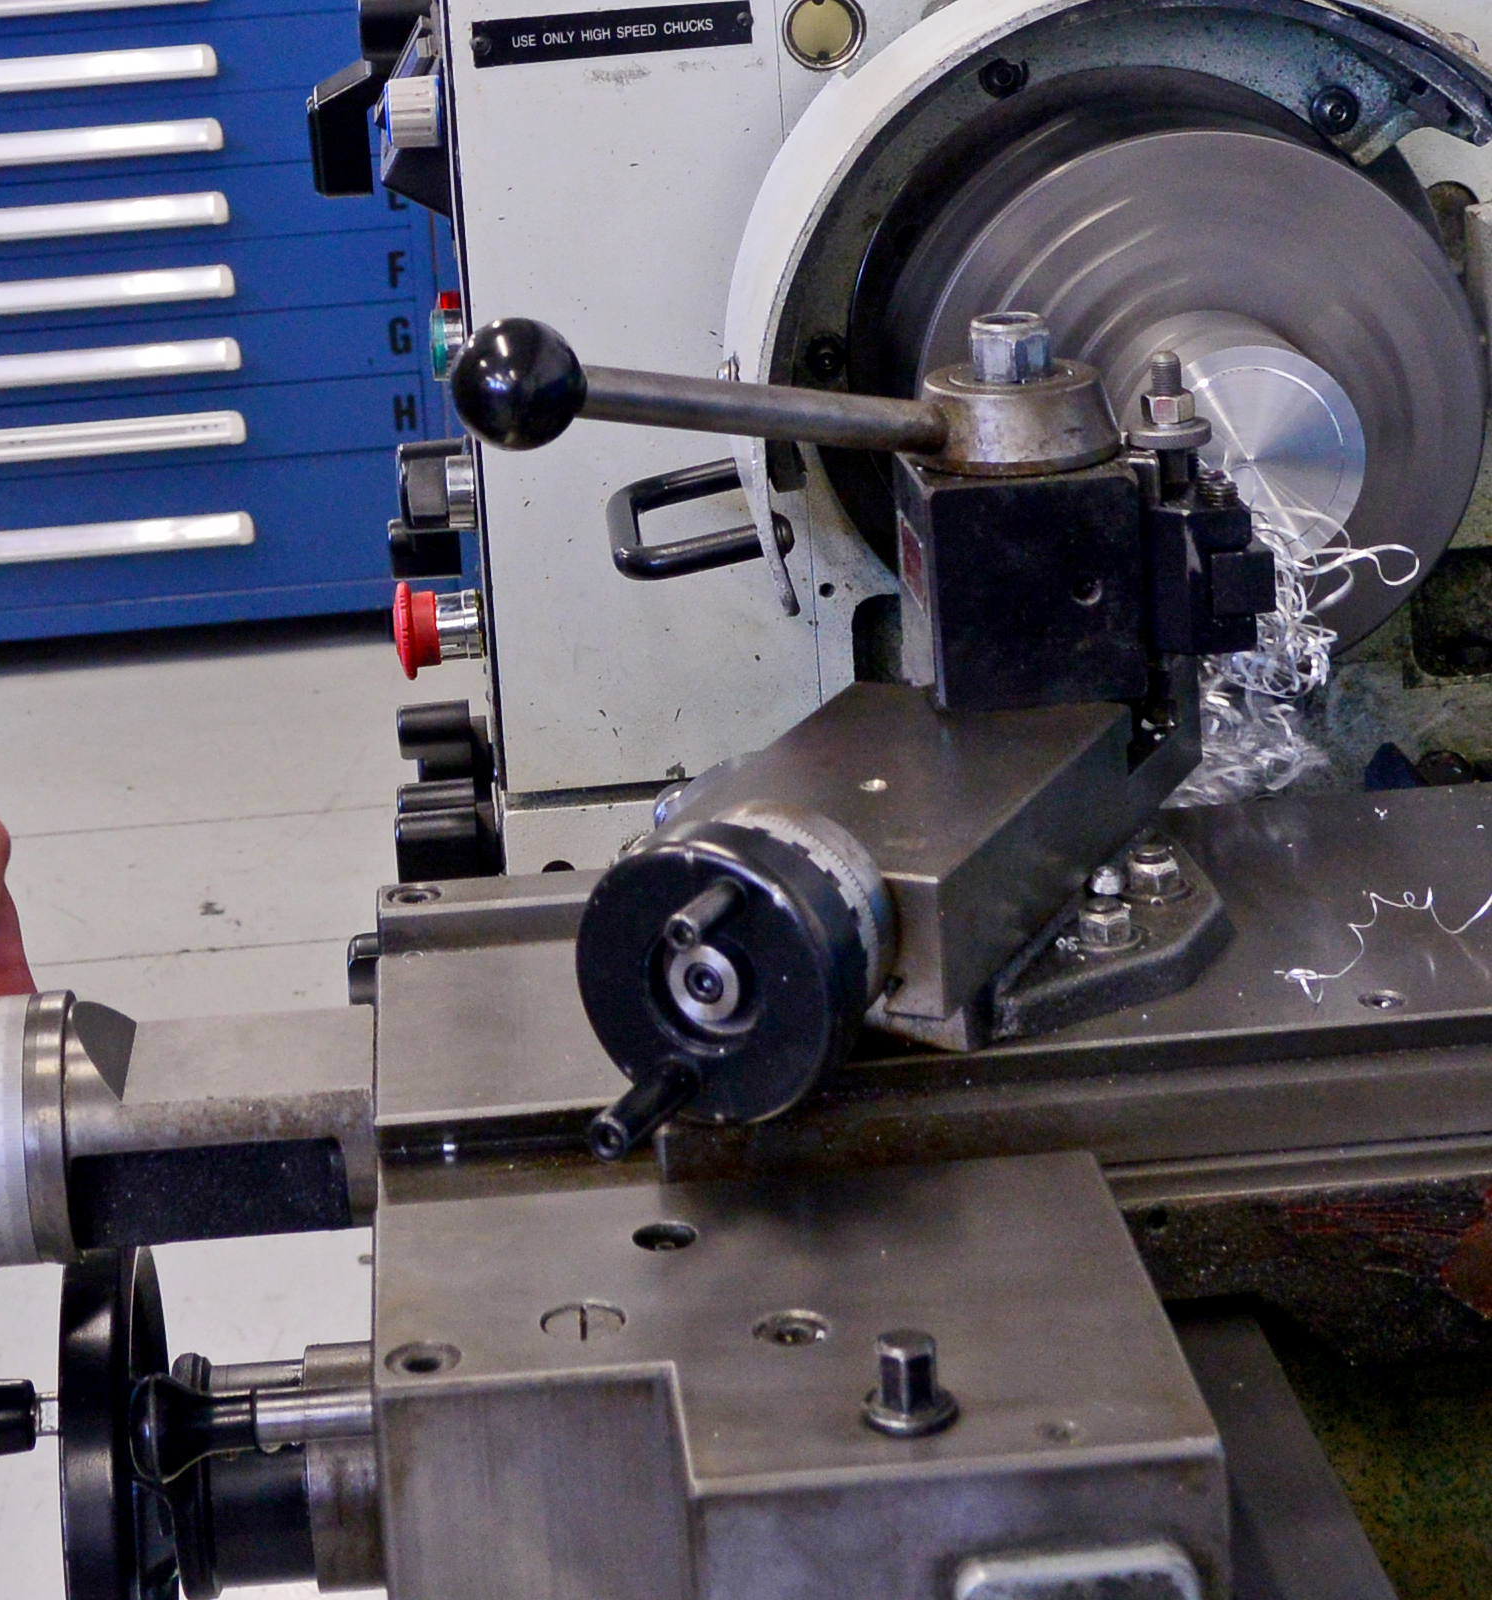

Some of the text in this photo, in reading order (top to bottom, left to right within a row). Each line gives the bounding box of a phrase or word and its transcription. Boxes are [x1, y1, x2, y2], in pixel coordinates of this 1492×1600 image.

[511, 18, 714, 48] USE ONLY HIGH SPEED CHUCKS
[389, 250, 405, 288] F
[389, 317, 412, 355] G
[393, 394, 416, 431] H
